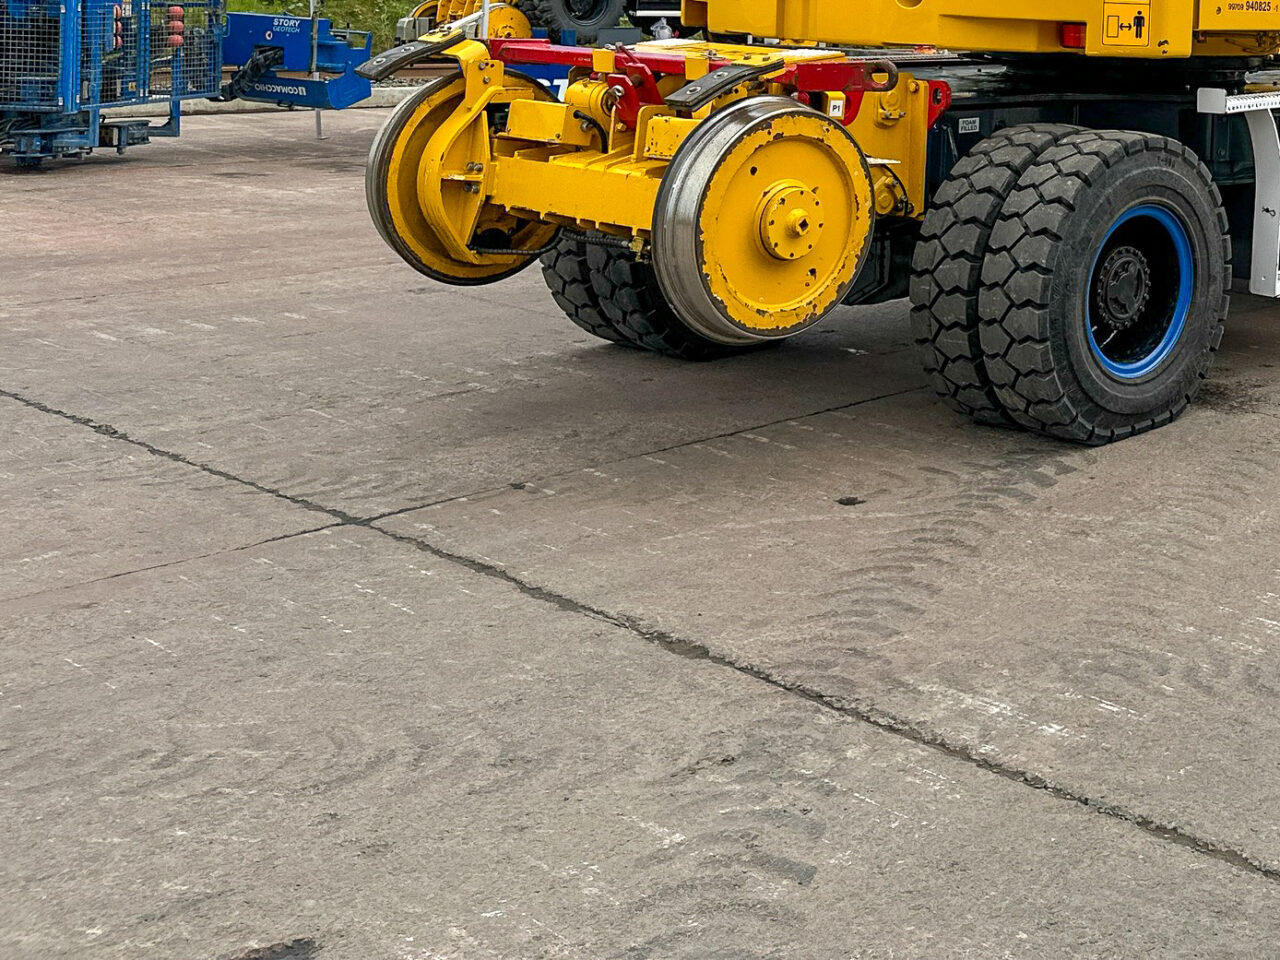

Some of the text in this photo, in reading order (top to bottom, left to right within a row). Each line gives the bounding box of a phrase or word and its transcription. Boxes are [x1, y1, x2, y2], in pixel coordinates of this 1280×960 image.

[1245, 0, 1271, 12] 940825
[273, 18, 301, 27] STORY
[254, 83, 299, 95] COMACCHIO
[832, 104, 841, 112] P1
